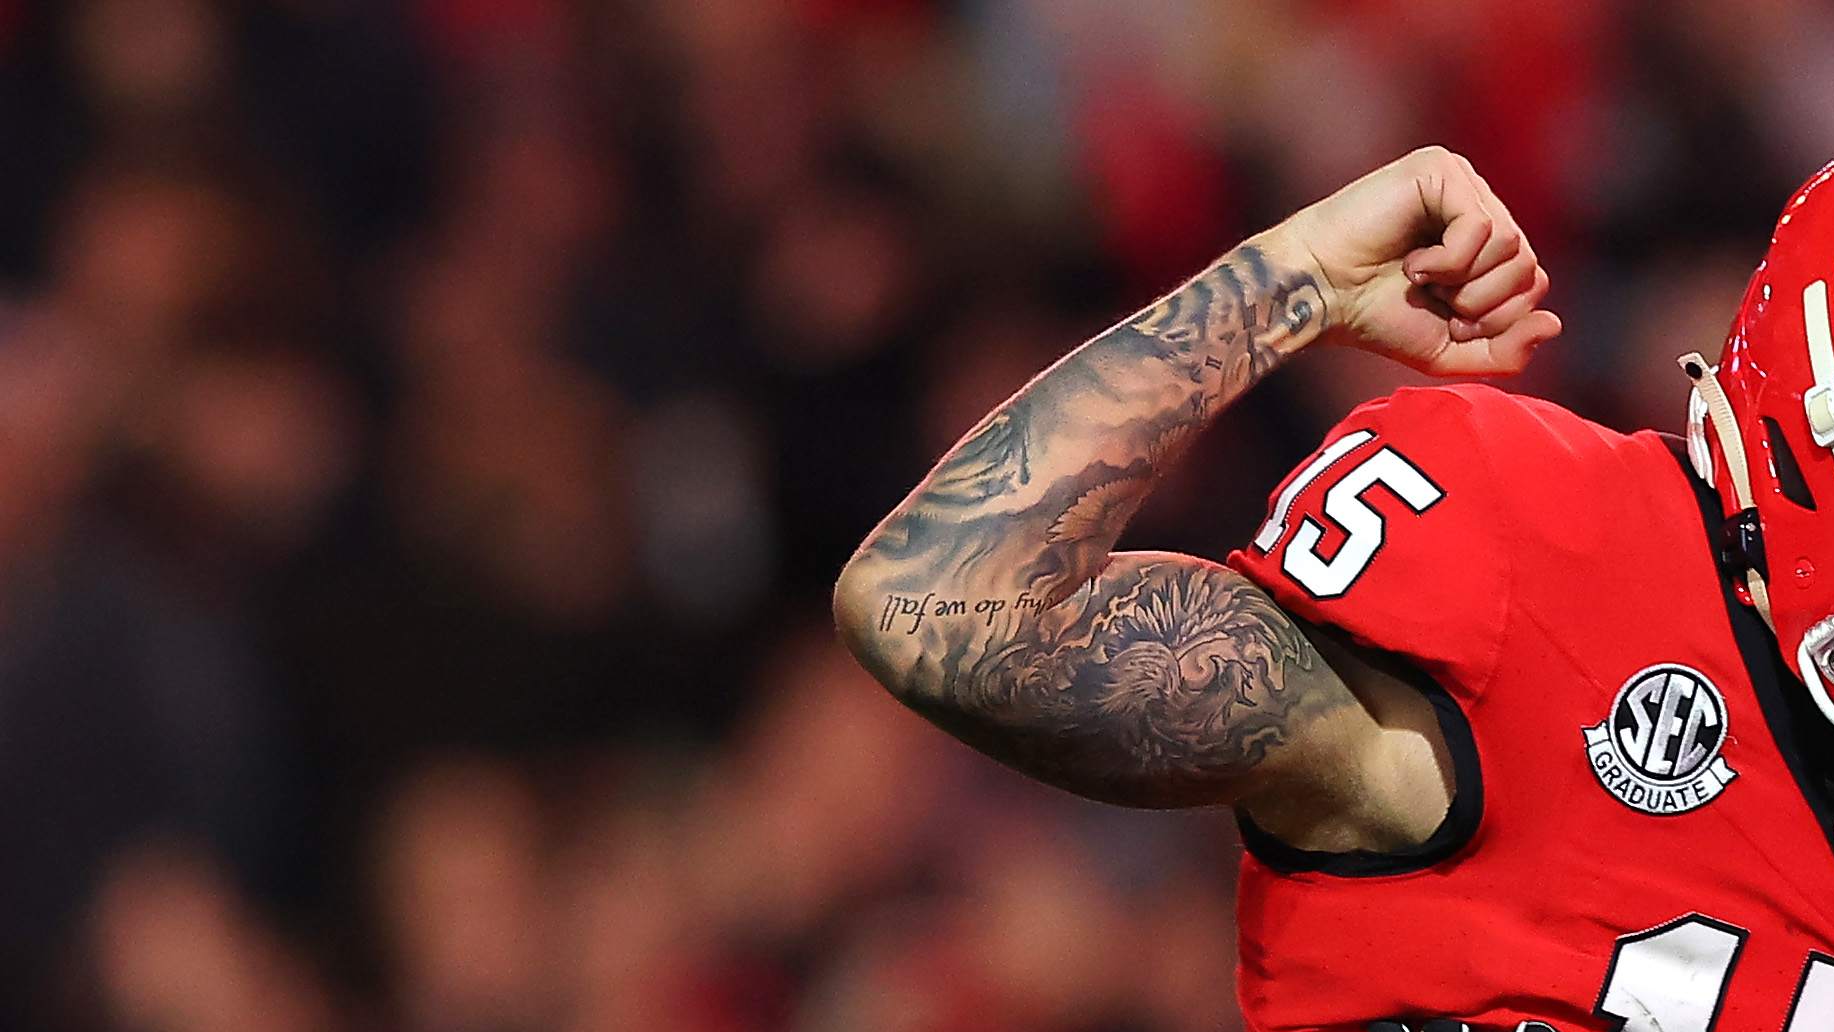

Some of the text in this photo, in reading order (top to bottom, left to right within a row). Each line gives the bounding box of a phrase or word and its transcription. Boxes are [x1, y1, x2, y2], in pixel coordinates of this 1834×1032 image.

[1254, 430, 1447, 599] 15
[880, 593, 935, 635] fall
[935, 600, 966, 616] we
[975, 599, 1006, 626] do
[1619, 672, 1720, 777] SEC
[1594, 750, 1710, 811] GRADUATE
